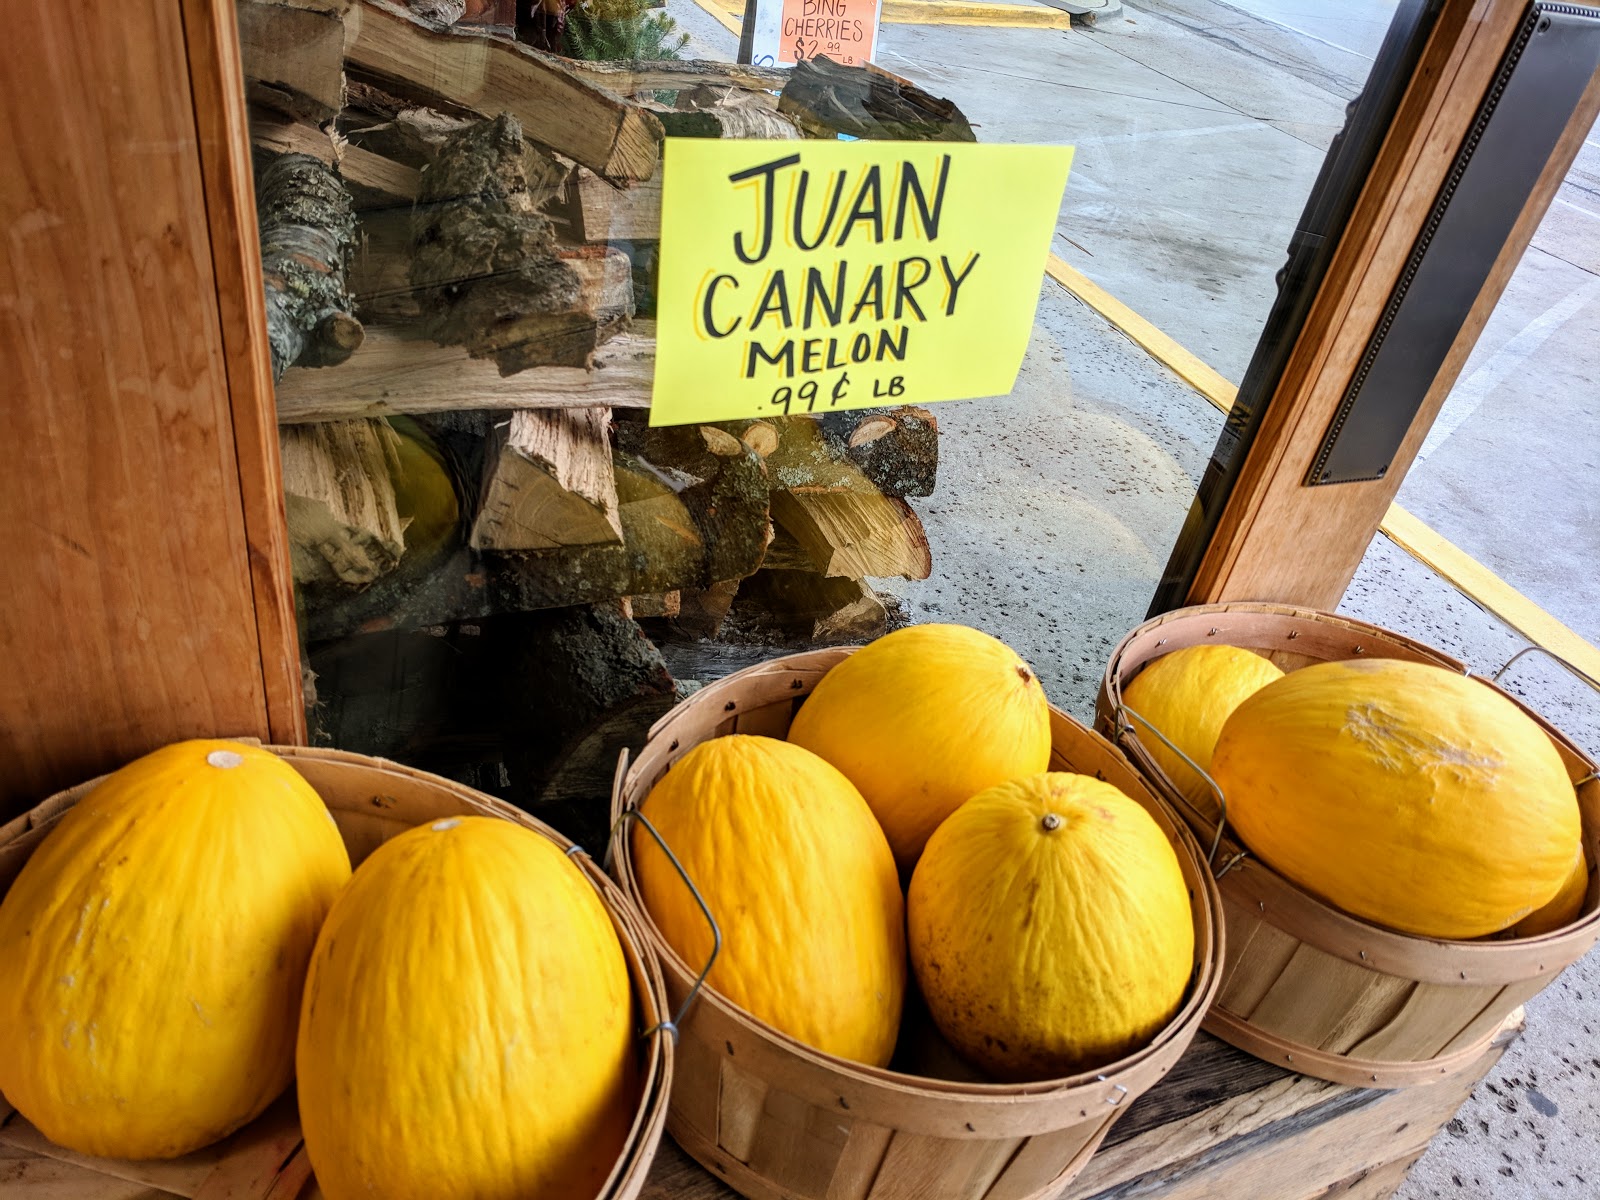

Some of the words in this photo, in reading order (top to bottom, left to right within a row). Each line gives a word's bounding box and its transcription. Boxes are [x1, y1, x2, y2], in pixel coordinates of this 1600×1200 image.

[803, 0, 846, 17] BING
[785, 17, 863, 42] CHERRIES
[842, 56, 853, 64] LB
[729, 152, 951, 264] JUAN
[700, 253, 980, 338] CANARY
[746, 326, 909, 378] MELON
[873, 375, 905, 397] LB
